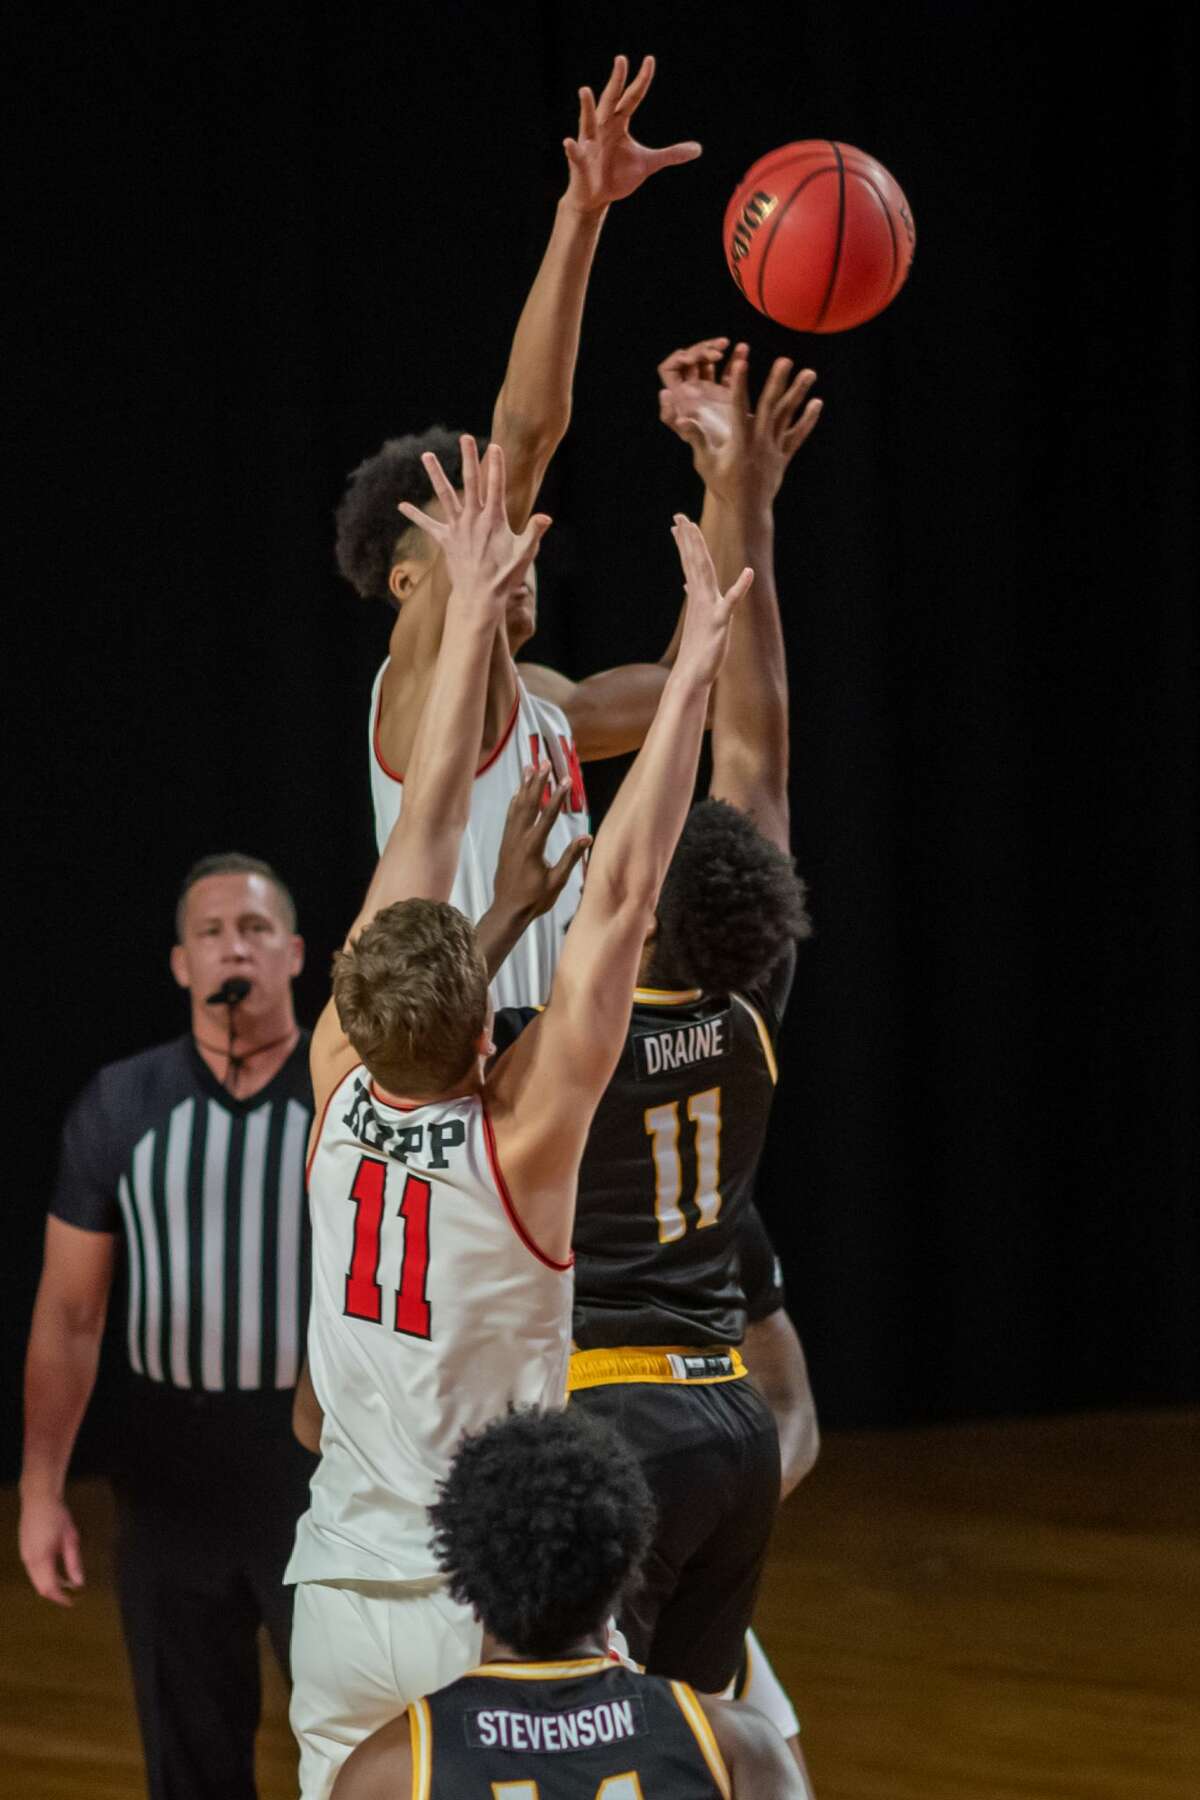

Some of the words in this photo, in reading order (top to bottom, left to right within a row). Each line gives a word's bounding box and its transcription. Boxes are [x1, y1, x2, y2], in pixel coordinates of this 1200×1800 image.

[643, 1018, 724, 1076] DRAINE
[342, 1077, 466, 1170] KOPP
[644, 1086, 722, 1245] 11
[342, 1154, 432, 1342] 11
[477, 1699, 636, 1751] STEVENSON
